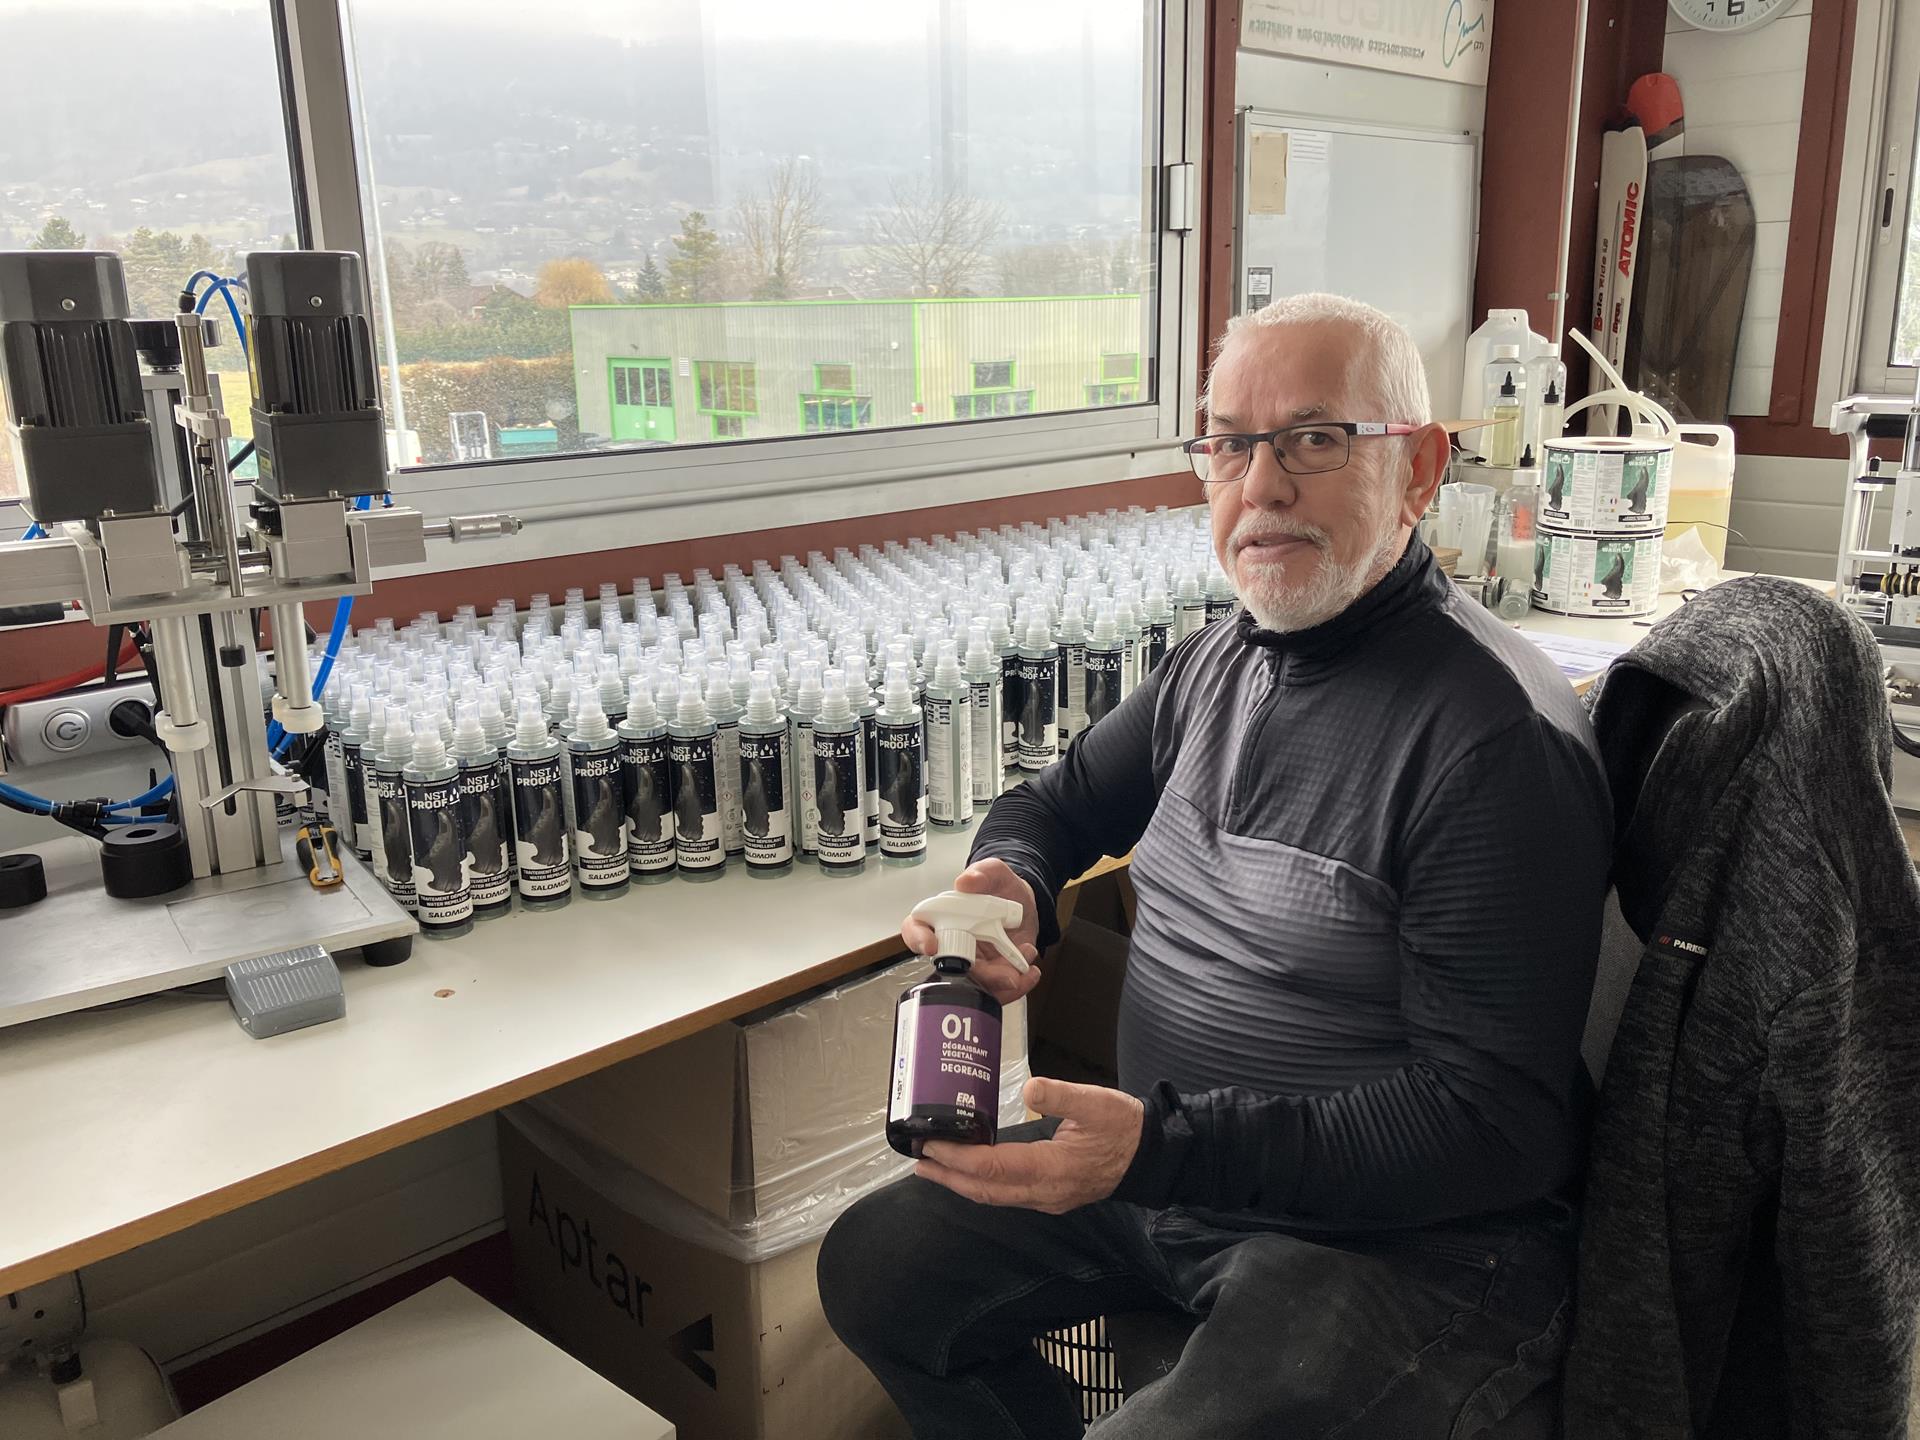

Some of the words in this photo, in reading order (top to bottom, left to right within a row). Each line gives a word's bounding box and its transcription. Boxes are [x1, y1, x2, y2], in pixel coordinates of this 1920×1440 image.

[1728, 0, 1744, 16] 6
[1618, 182, 1639, 280] ATOMIC
[889, 733, 909, 741] NST
[630, 748, 650, 756] NST
[587, 758, 608, 769] NST
[530, 767, 551, 777] NST
[575, 768, 609, 777] PROOF
[467, 775, 489, 786] NST
[517, 775, 551, 786] PROOF
[424, 790, 447, 801] NST
[411, 800, 448, 810] PROOF
[588, 869, 626, 880] SALOMON
[531, 879, 568, 891] SALOMON
[428, 904, 470, 918] SALOMON
[941, 1013, 979, 1043] 01.
[942, 1041, 988, 1058] DÉGRAISSANT
[941, 1063, 991, 1082] DEGREASER
[956, 1091, 976, 1105] ERA
[529, 1171, 653, 1328] Aptar
